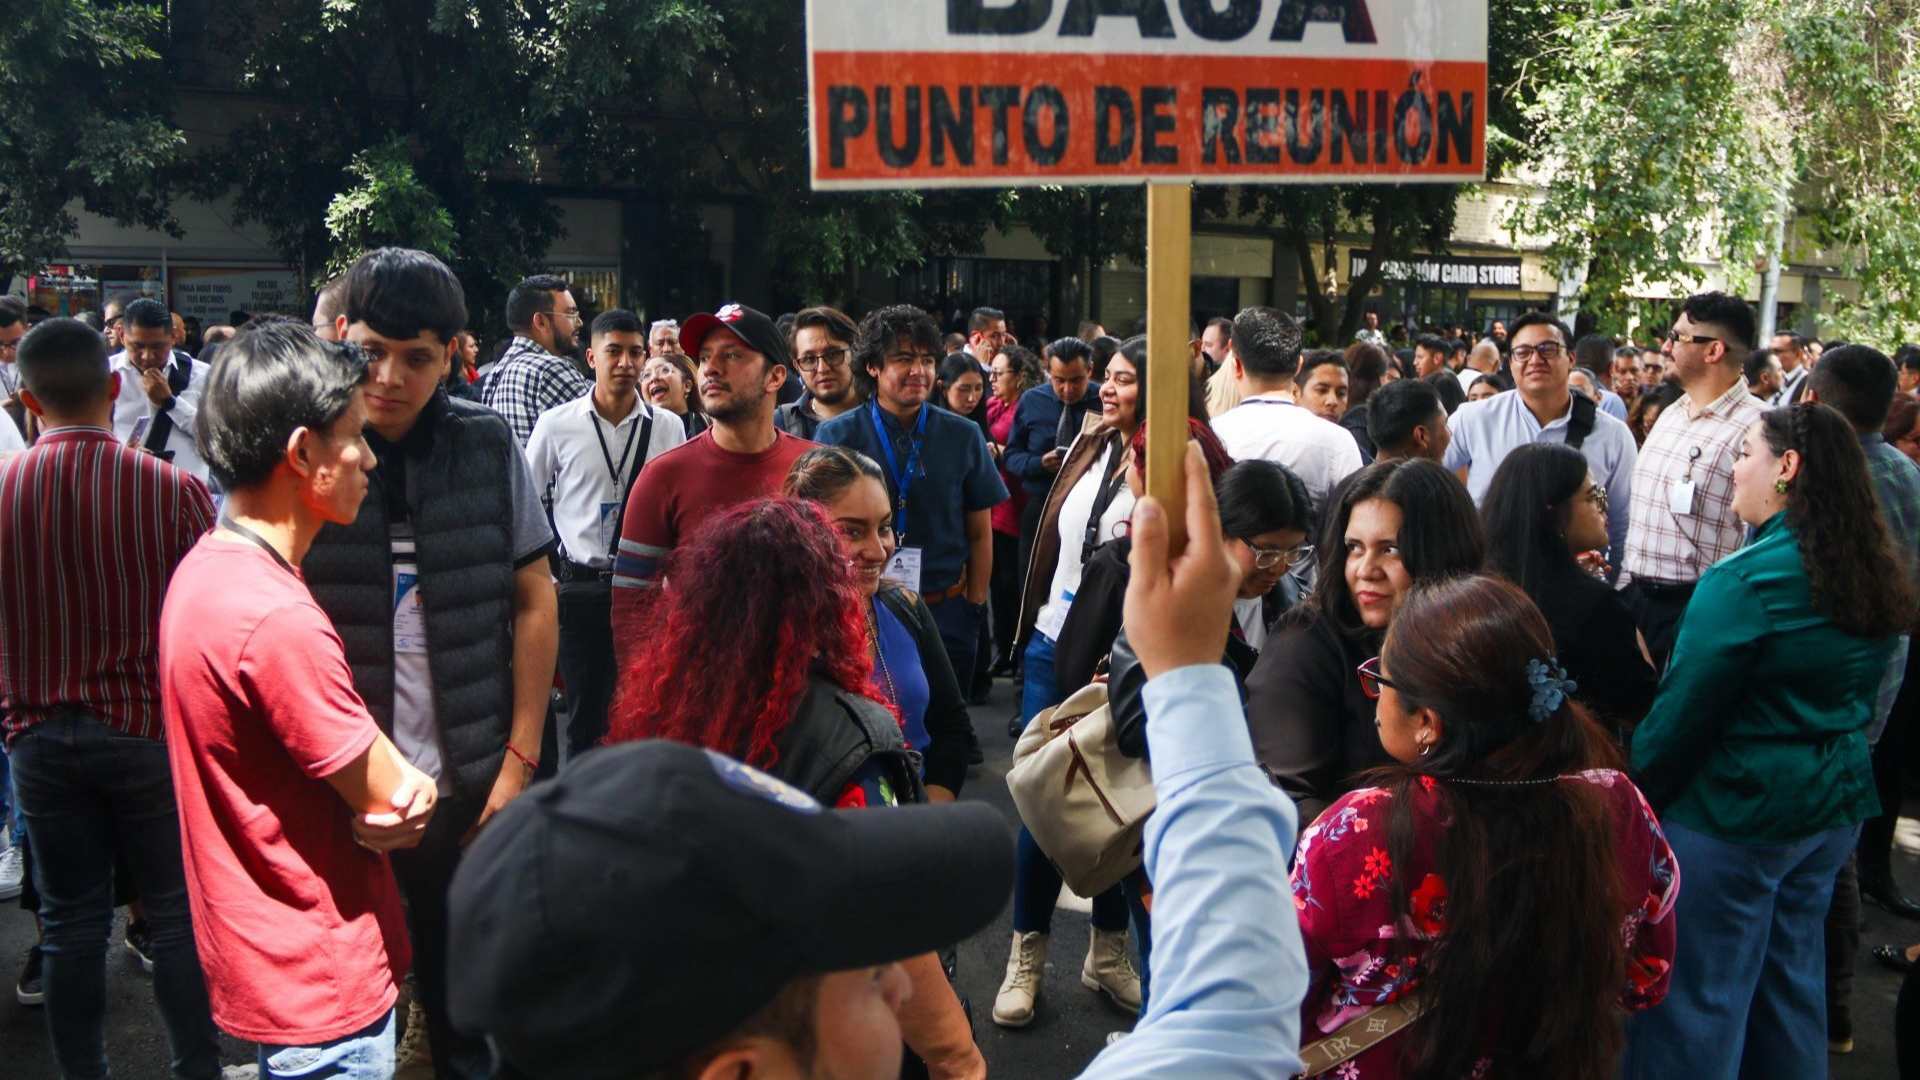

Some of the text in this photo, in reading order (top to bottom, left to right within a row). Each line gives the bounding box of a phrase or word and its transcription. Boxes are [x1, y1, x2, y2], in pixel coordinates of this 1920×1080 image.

[827, 69, 1474, 169] PUNTO DE REUNIÓN
[1441, 263, 1478, 284] CARD
[1479, 264, 1520, 285] STORE
